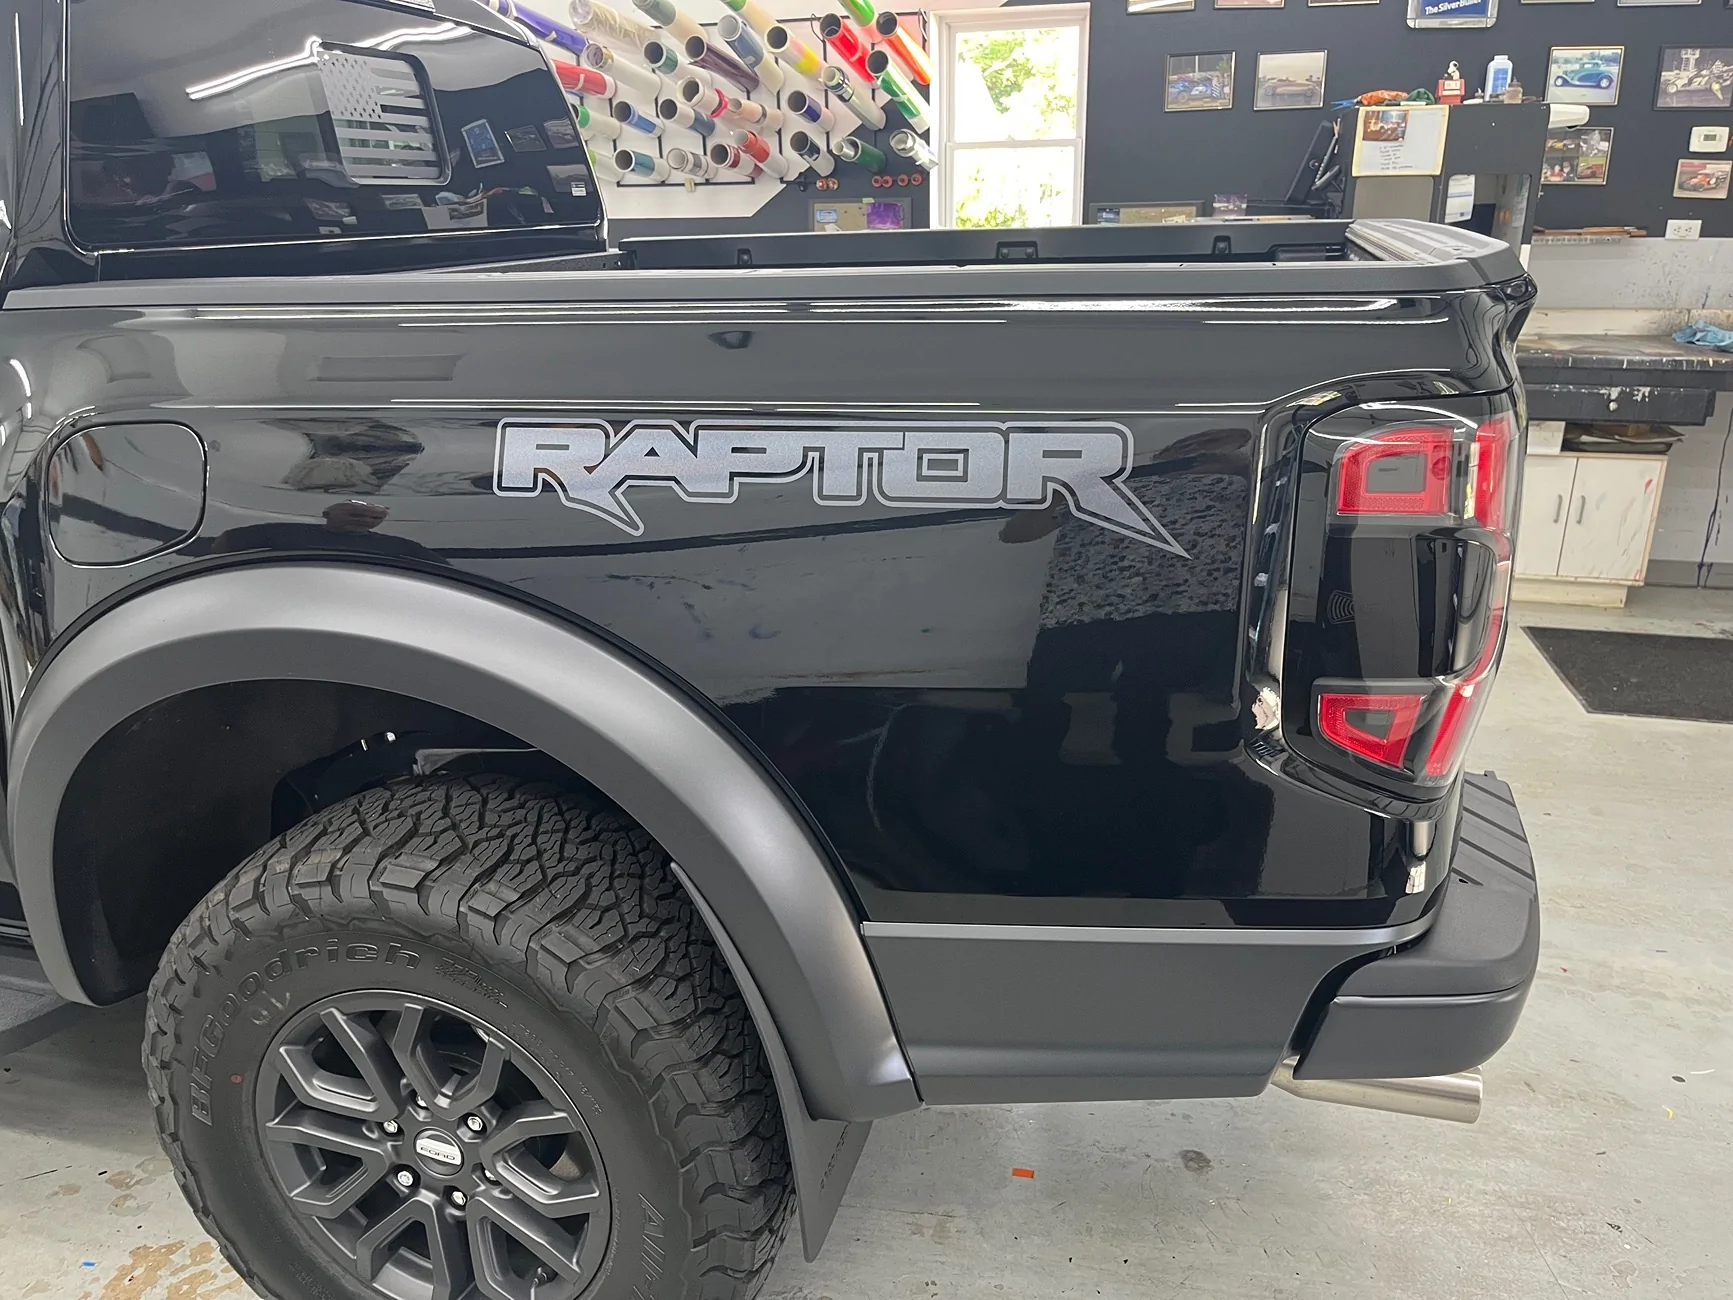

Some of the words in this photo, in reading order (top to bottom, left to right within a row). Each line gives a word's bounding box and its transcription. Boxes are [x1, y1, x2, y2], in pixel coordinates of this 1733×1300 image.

[1425, 5, 1438, 15] The
[1438, 1, 1460, 12] Silver
[494, 418, 1193, 560] RAPTOR
[189, 937, 421, 1127] BFGoodrich
[420, 1146, 456, 1161] FORD
